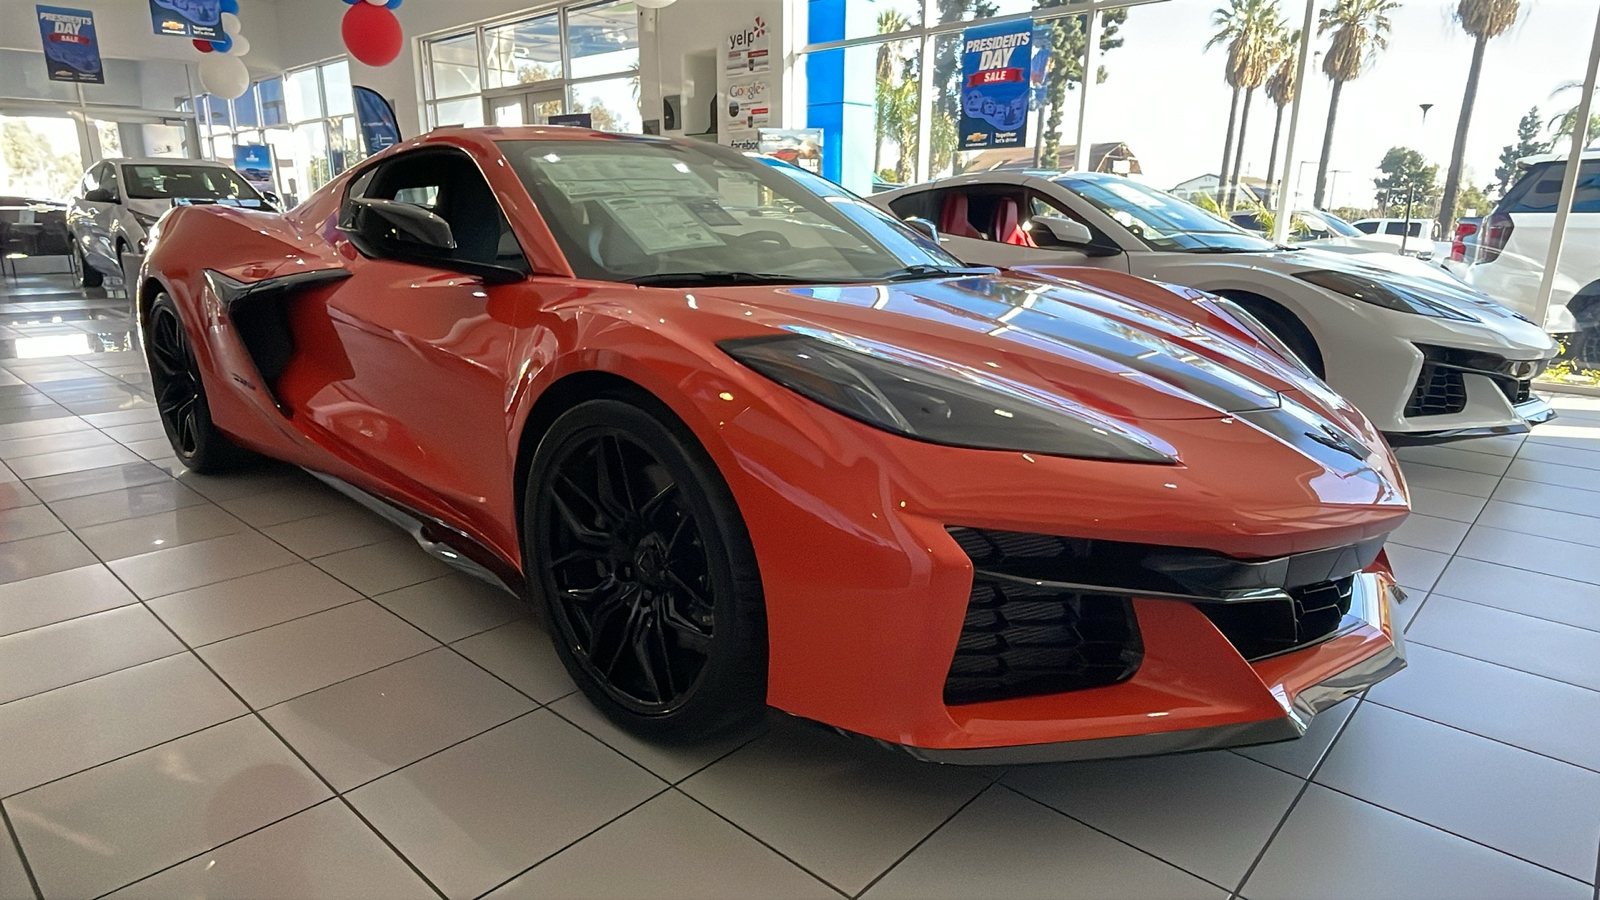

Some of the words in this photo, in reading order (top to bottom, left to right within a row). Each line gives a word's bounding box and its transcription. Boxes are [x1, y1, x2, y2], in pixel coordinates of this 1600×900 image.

[55, 21, 81, 35] DAY
[730, 30, 754, 49] yelp
[966, 32, 1031, 53] PRESIDENTS
[979, 48, 1015, 71] DAY
[984, 71, 1006, 82] SALE
